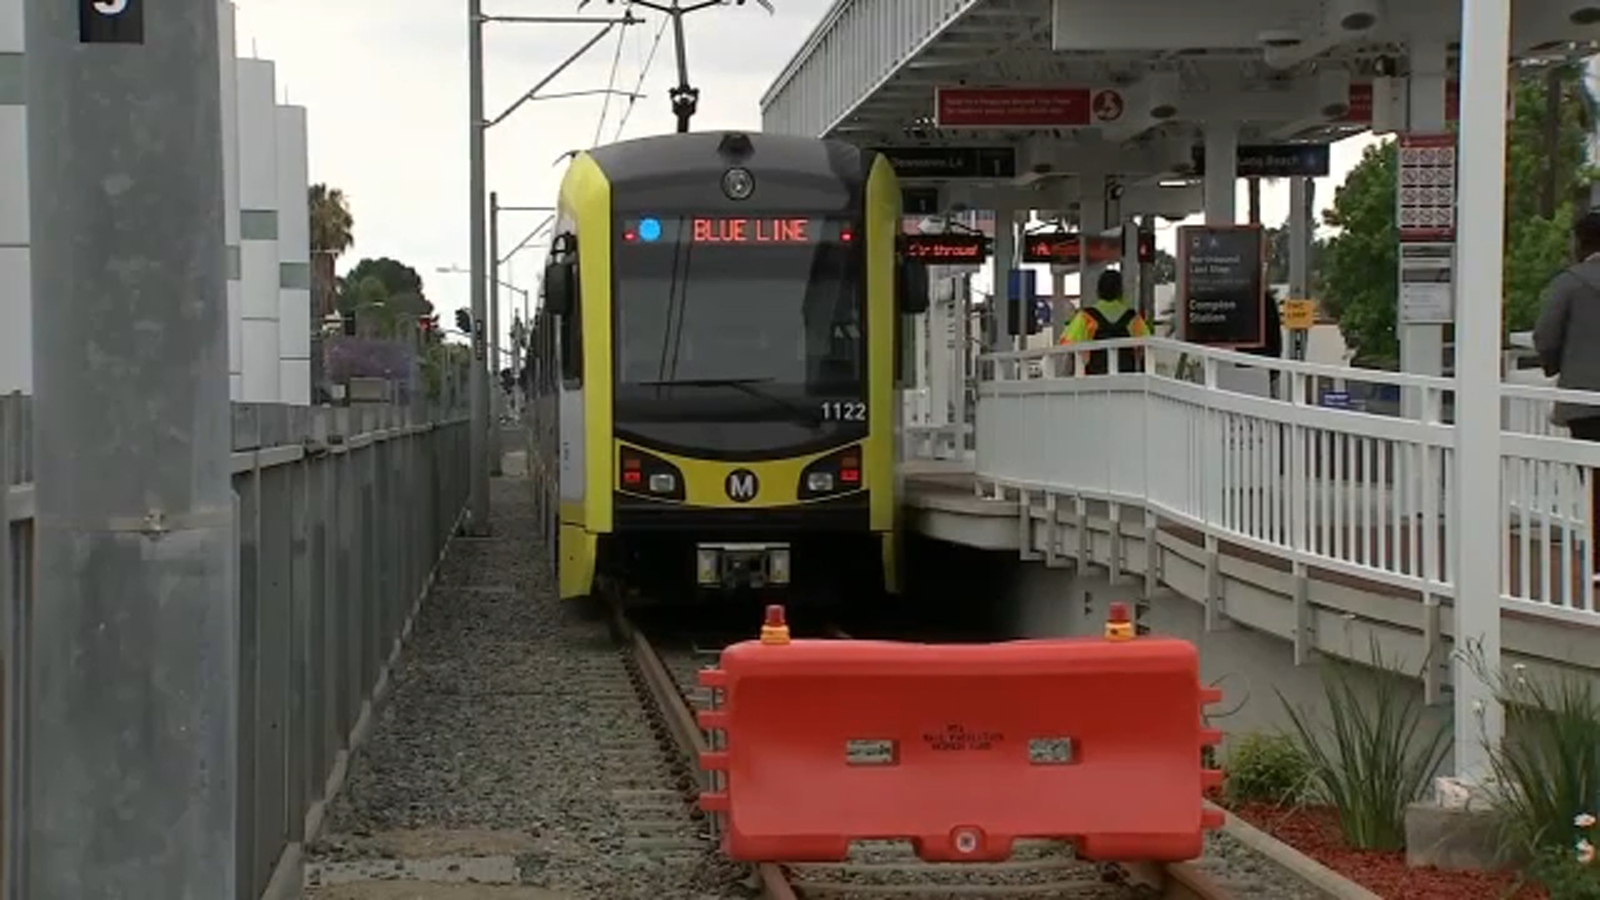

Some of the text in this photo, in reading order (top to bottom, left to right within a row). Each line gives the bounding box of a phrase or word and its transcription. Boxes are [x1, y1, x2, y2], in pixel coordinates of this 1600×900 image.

[694, 219, 808, 241] BLUE LINE
[821, 402, 867, 421] 1122
[730, 474, 754, 498] M
